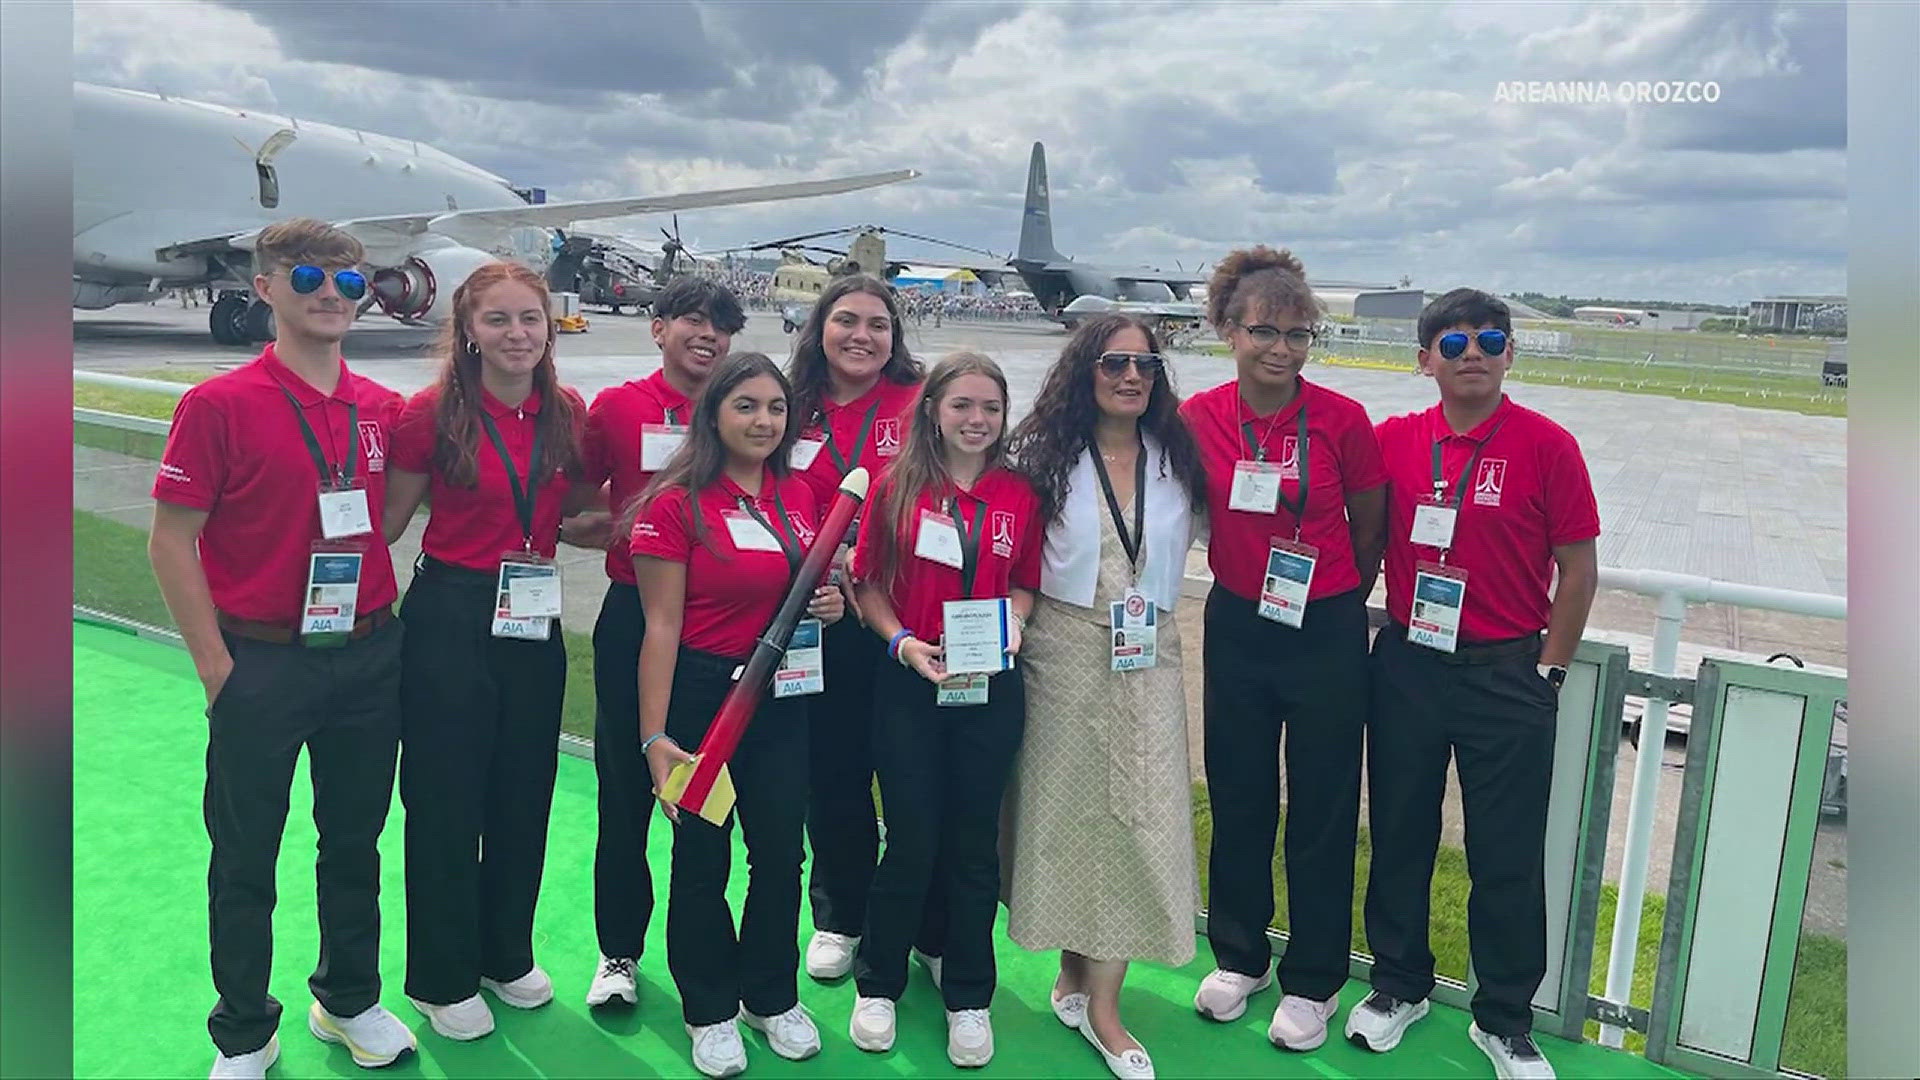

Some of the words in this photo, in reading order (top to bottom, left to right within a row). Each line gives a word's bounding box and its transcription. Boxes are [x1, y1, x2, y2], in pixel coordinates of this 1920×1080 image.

[310, 619, 332, 630] AIA
[502, 621, 524, 633] AIA
[783, 682, 803, 693] AIA
[946, 691, 967, 701] AIA
